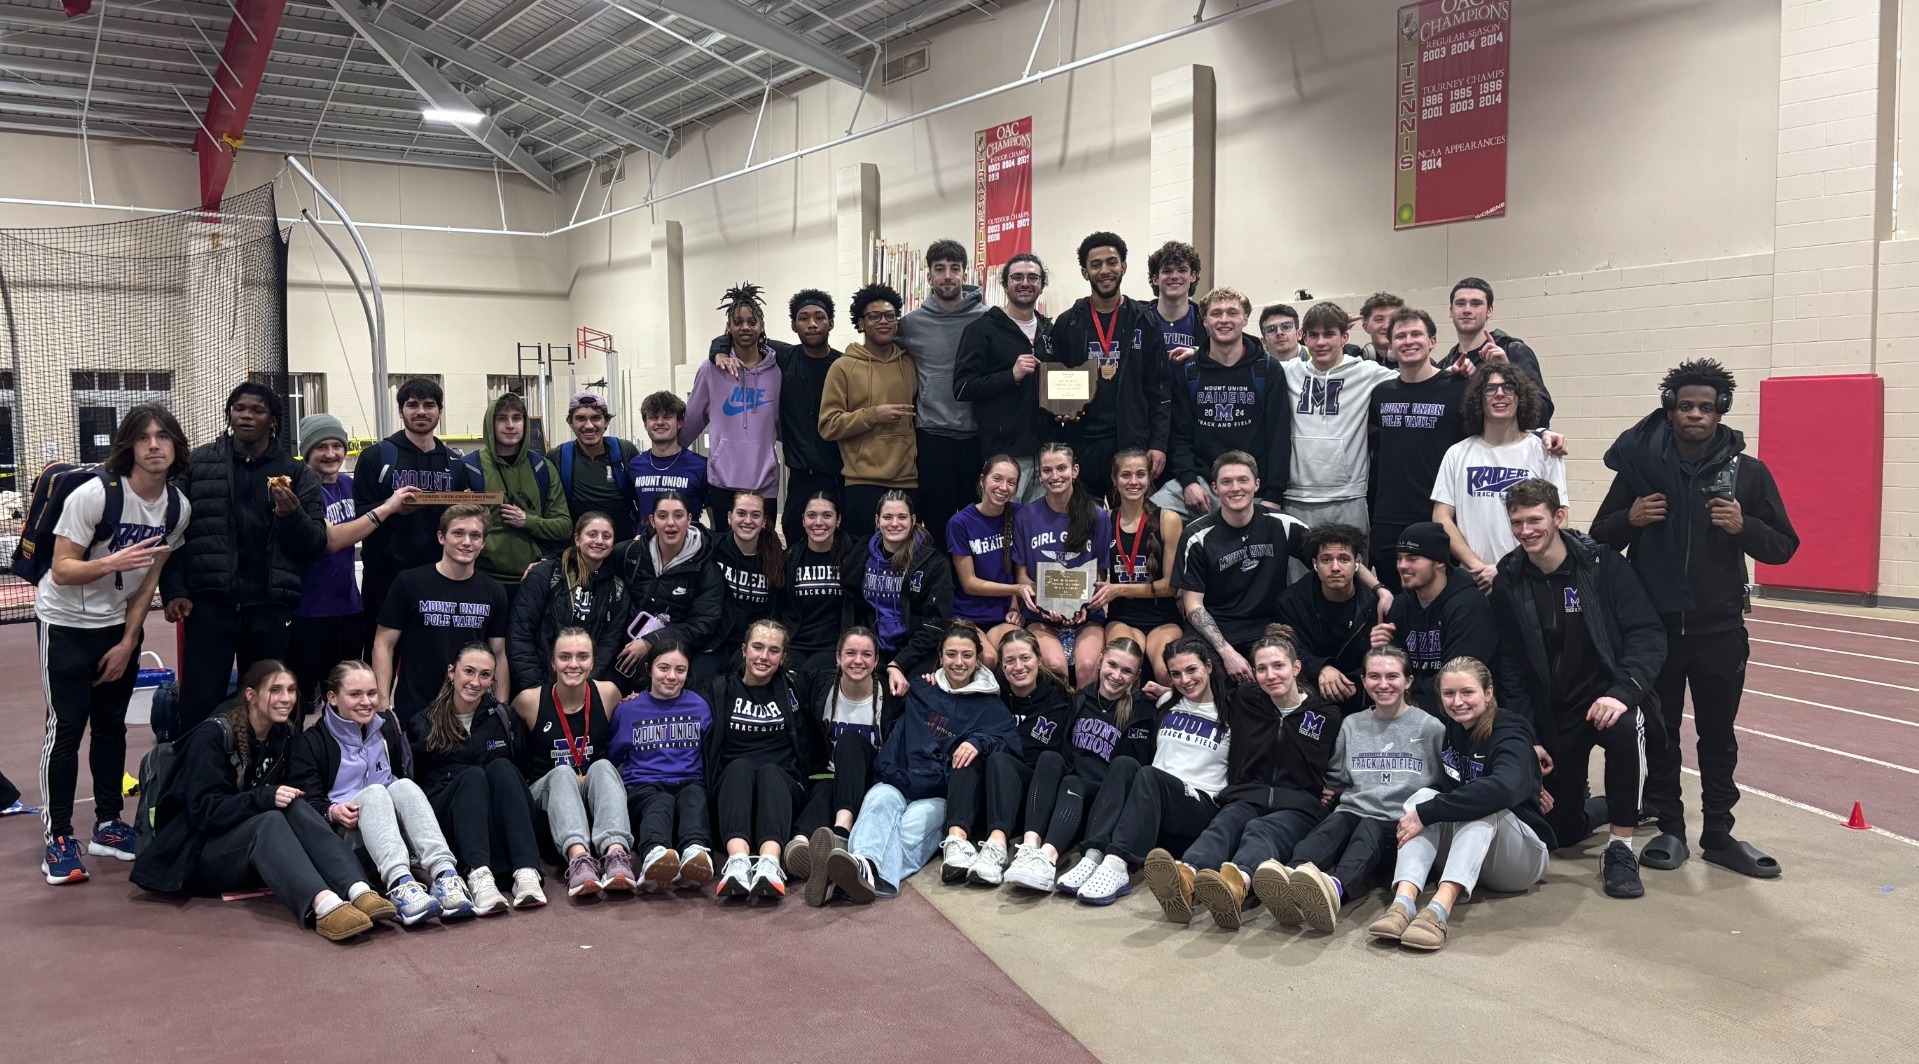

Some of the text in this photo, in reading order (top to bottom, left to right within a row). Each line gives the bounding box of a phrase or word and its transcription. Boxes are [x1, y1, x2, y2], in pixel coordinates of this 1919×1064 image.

[1420, 0, 1509, 42] CHAMPIONS
[1423, 31, 1504, 62] 2003 2004 2014
[1426, 23, 1500, 49] REGULAR SEASON
[1422, 69, 1505, 95] TOURNEY CHAMPS
[1450, 86, 1472, 101] 1995
[1400, 61, 1416, 171] TENNIS
[1422, 92, 1502, 120] 2001 2003 2014
[996, 122, 1020, 140] OAC
[986, 132, 1031, 158] CHAMPIONS
[1417, 135, 1506, 160] NCAA APPEARANCES
[1421, 157, 1443, 171] 2014
[1197, 392, 1255, 404] RAIDERS
[1297, 376, 1345, 415] M
[1204, 404, 1245, 421] 20 M 24
[1412, 403, 1445, 416] UNION
[1198, 419, 1215, 428] TRACK
[1233, 419, 1252, 428] FIELD
[1404, 416, 1438, 428] VAULT
[391, 470, 452, 491] MOUNT
[635, 475, 689, 489] MOUNT UNION
[1467, 466, 1529, 497] RAIDERS
[1031, 531, 1091, 552] GIRL GG
[717, 561, 769, 590] AIDER
[795, 565, 841, 582] RAIDE
[419, 600, 490, 616] MOUNT UNION
[424, 613, 484, 628] POLE VAULT
[632, 721, 701, 746] MOUNT UNION
[1032, 715, 1058, 741] M
[1073, 717, 1122, 746] MOUNT
[1300, 711, 1326, 735] M
[1072, 733, 1114, 762] UNION
[1160, 729, 1182, 739] TRACK
[1194, 737, 1219, 751] FIELD
[1351, 759, 1423, 772] TRACK AND FIELD
[1381, 772, 1392, 784] M
